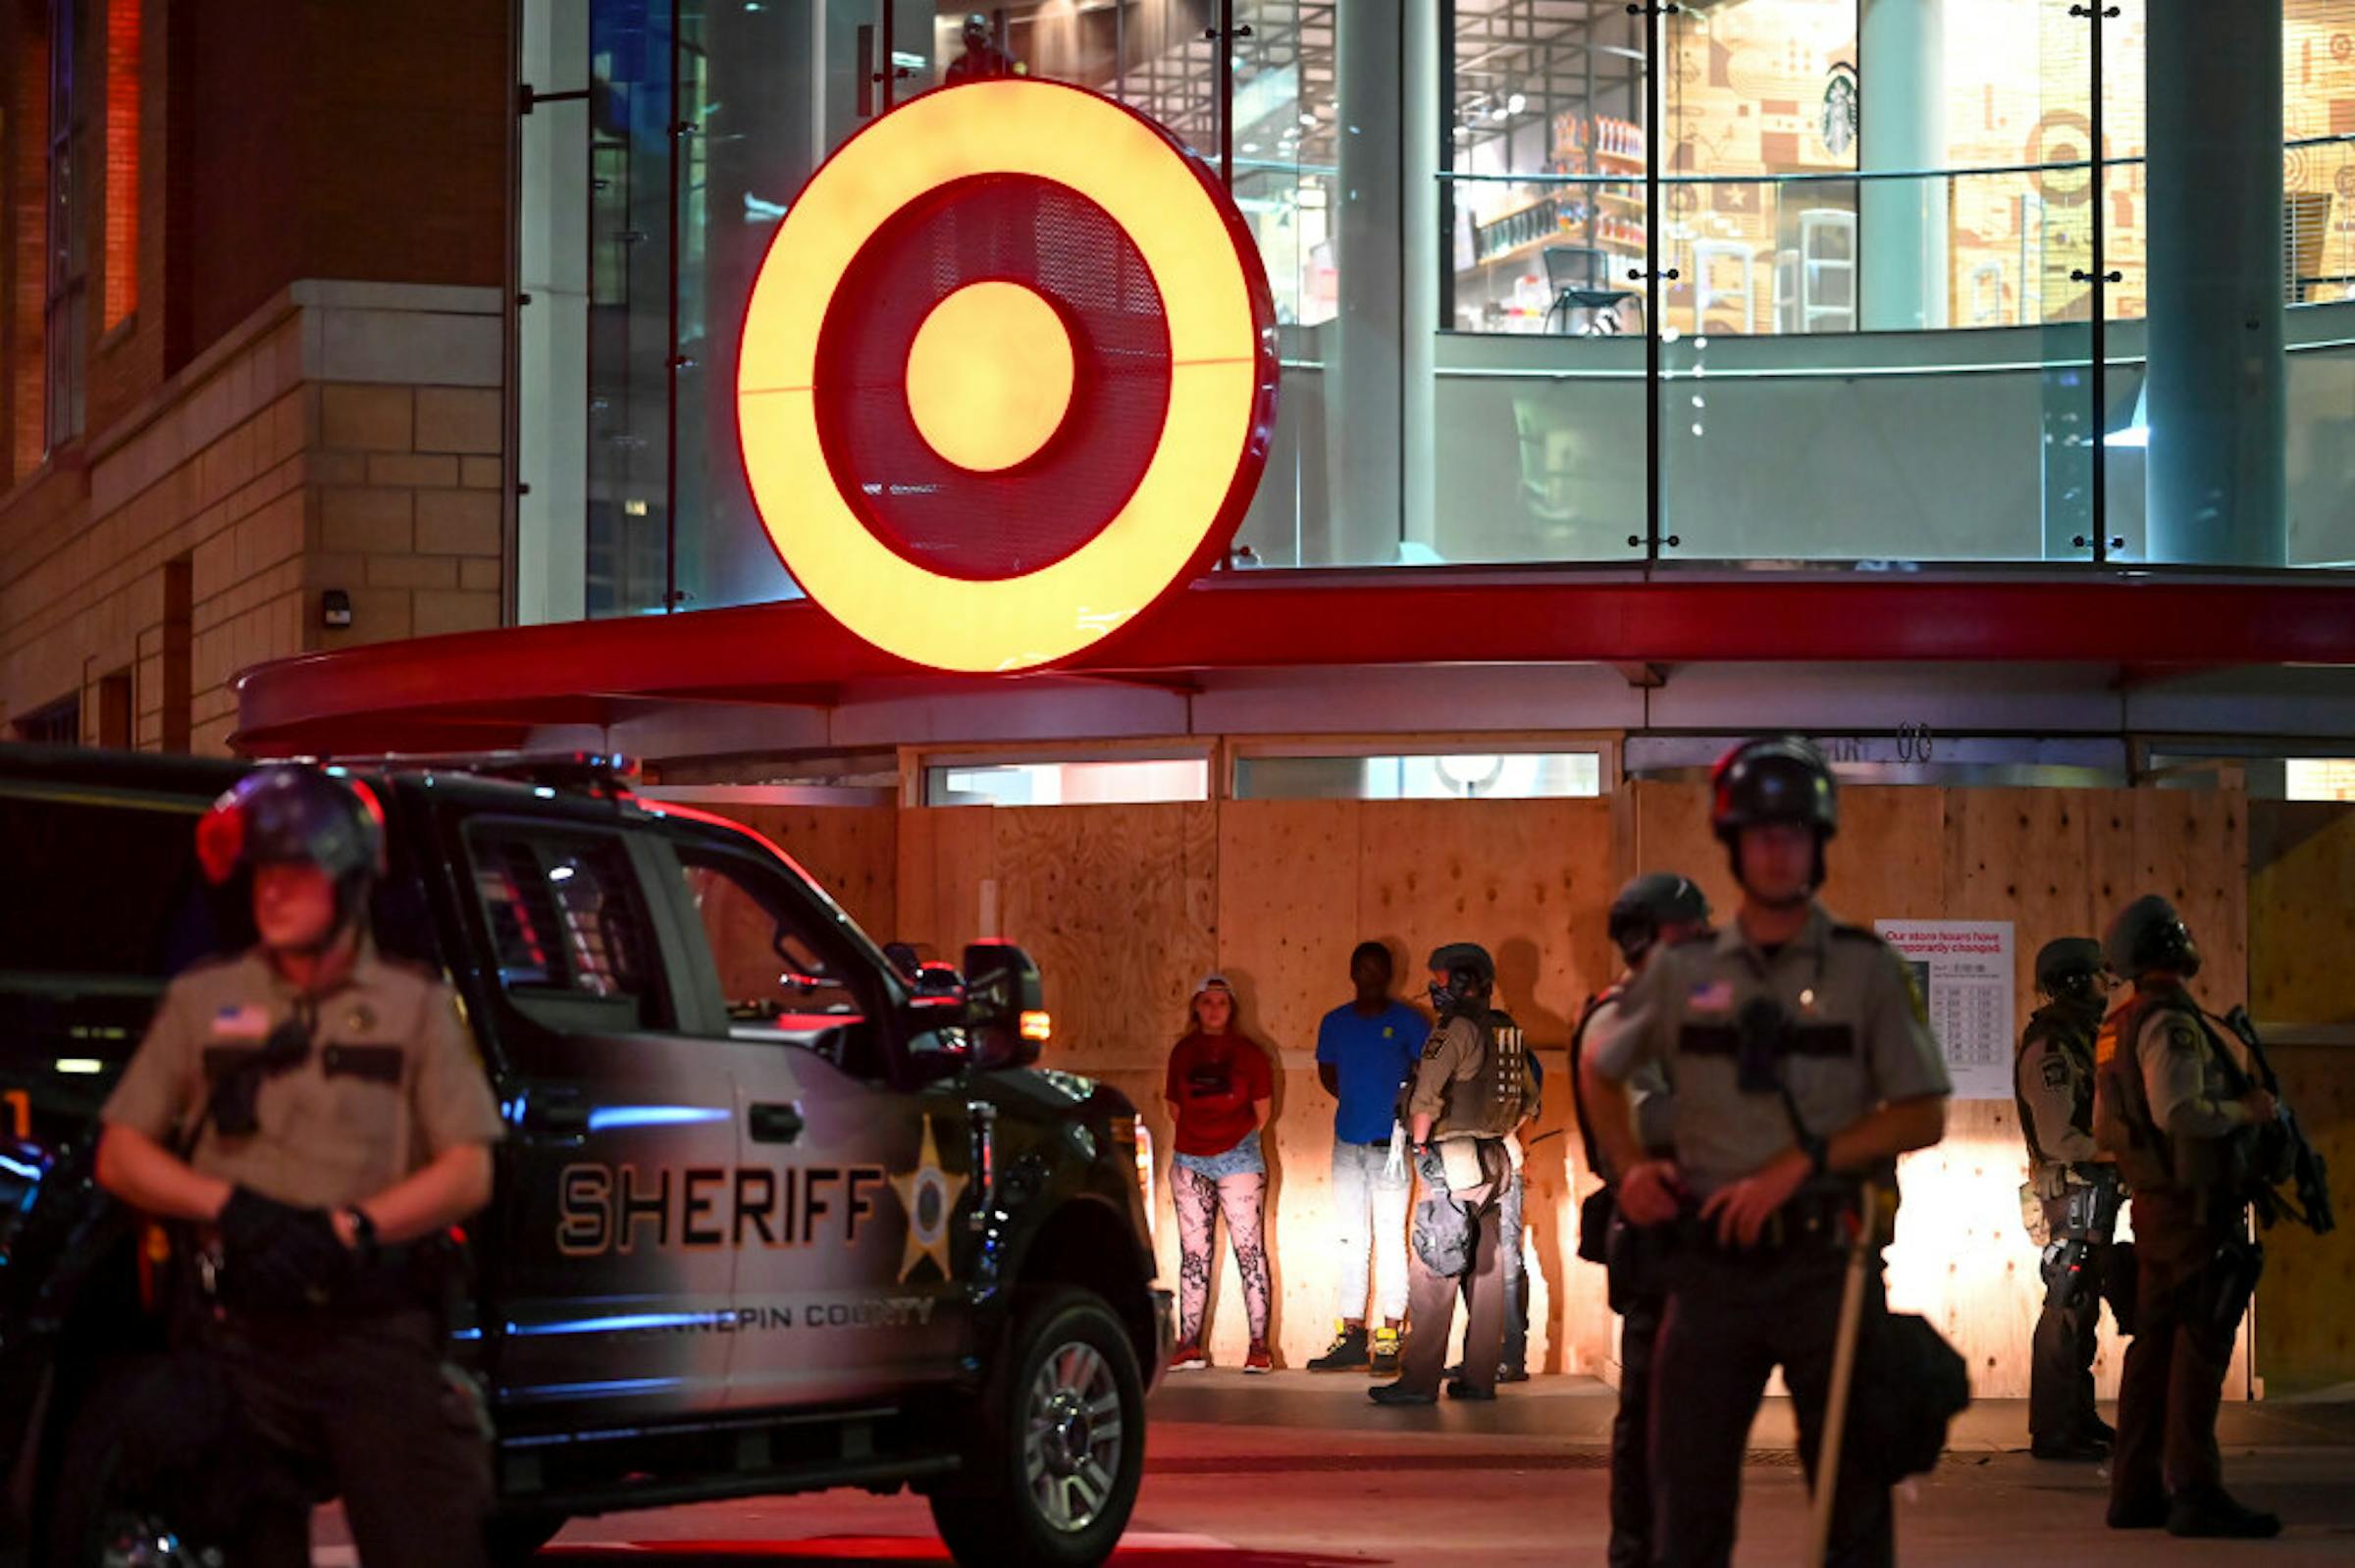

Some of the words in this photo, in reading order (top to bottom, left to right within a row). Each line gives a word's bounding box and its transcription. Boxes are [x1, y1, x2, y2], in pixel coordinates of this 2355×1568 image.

[1884, 930, 1905, 941] Our
[1909, 931, 1937, 941] store
[1939, 931, 1970, 941] hours
[1972, 931, 2000, 941] have
[1897, 943, 1948, 954] mporarily
[1952, 943, 2001, 954] changed
[557, 1163, 884, 1256] SHERIFF
[805, 1294, 936, 1328] COUNTY
